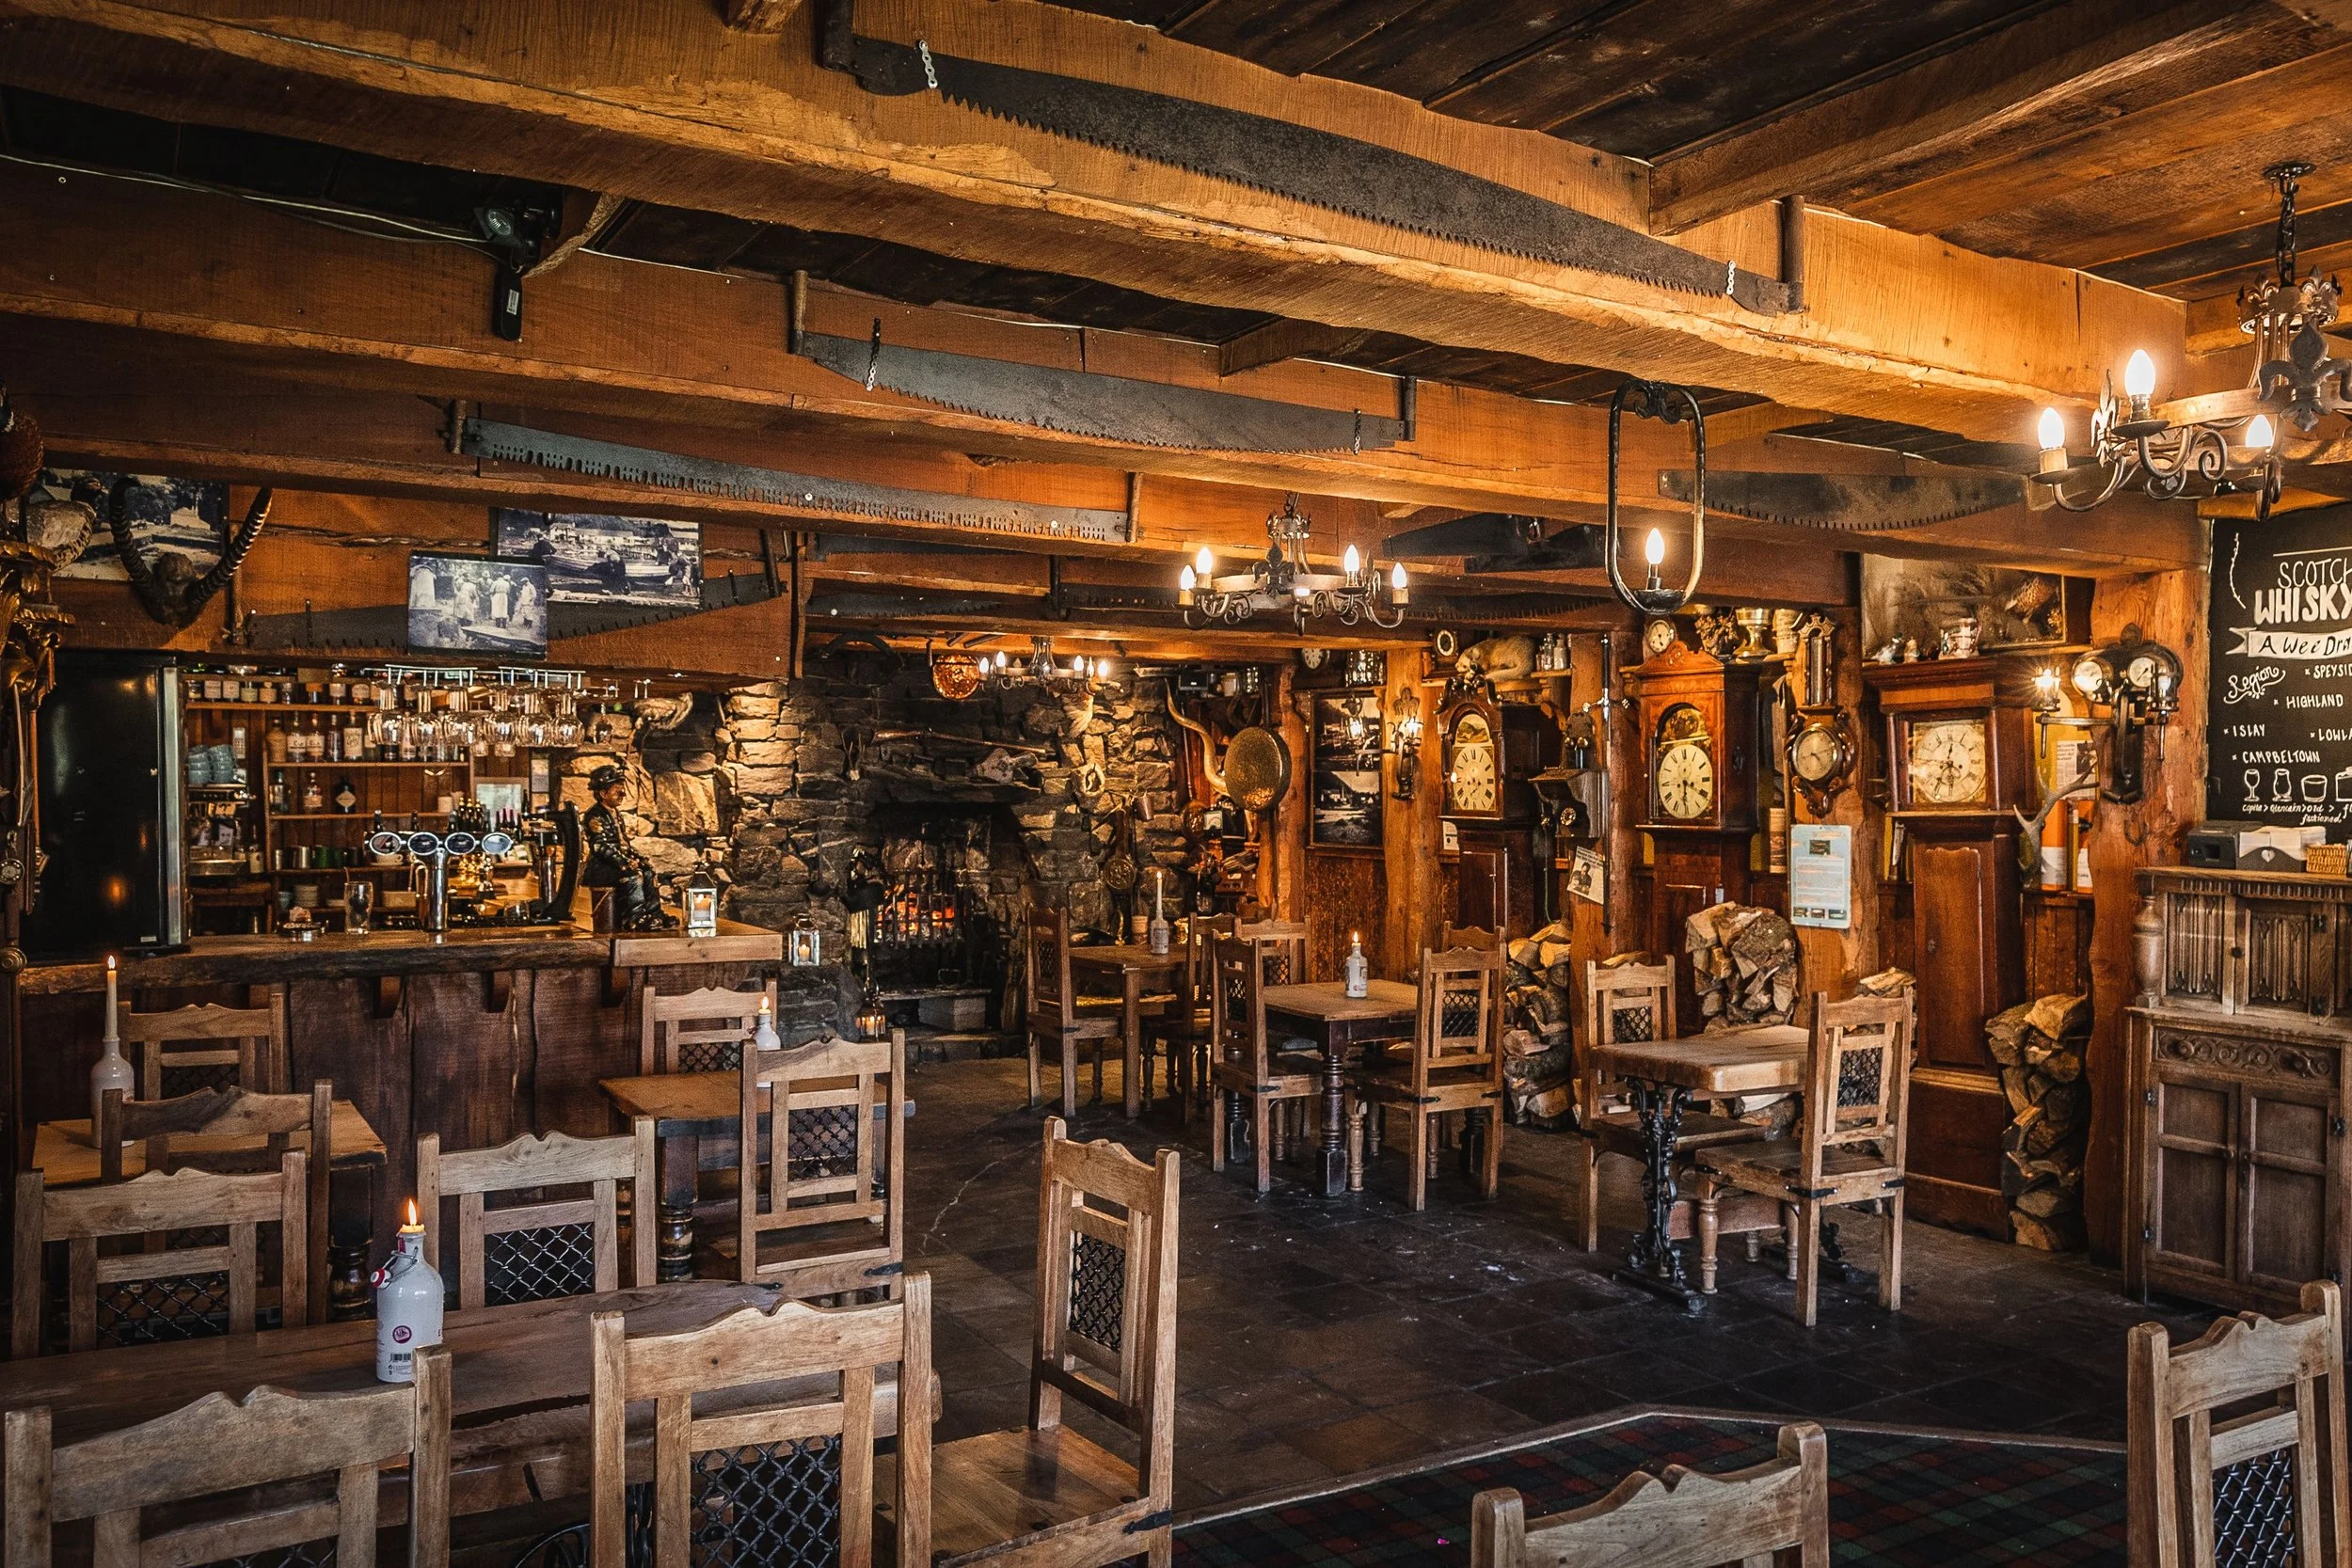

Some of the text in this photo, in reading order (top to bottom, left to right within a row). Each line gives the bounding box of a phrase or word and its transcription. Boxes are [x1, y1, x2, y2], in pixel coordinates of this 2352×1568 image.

[2254, 582, 2352, 626] WHISKY
[2258, 635, 2277, 655] A
[2282, 636, 2321, 655] Wee
[2228, 665, 2280, 699] Region
[2286, 693, 2344, 709] HIGHLAND
[2233, 723, 2265, 737] ISLAY
[2242, 750, 2321, 764] CAMPBELTOWN
